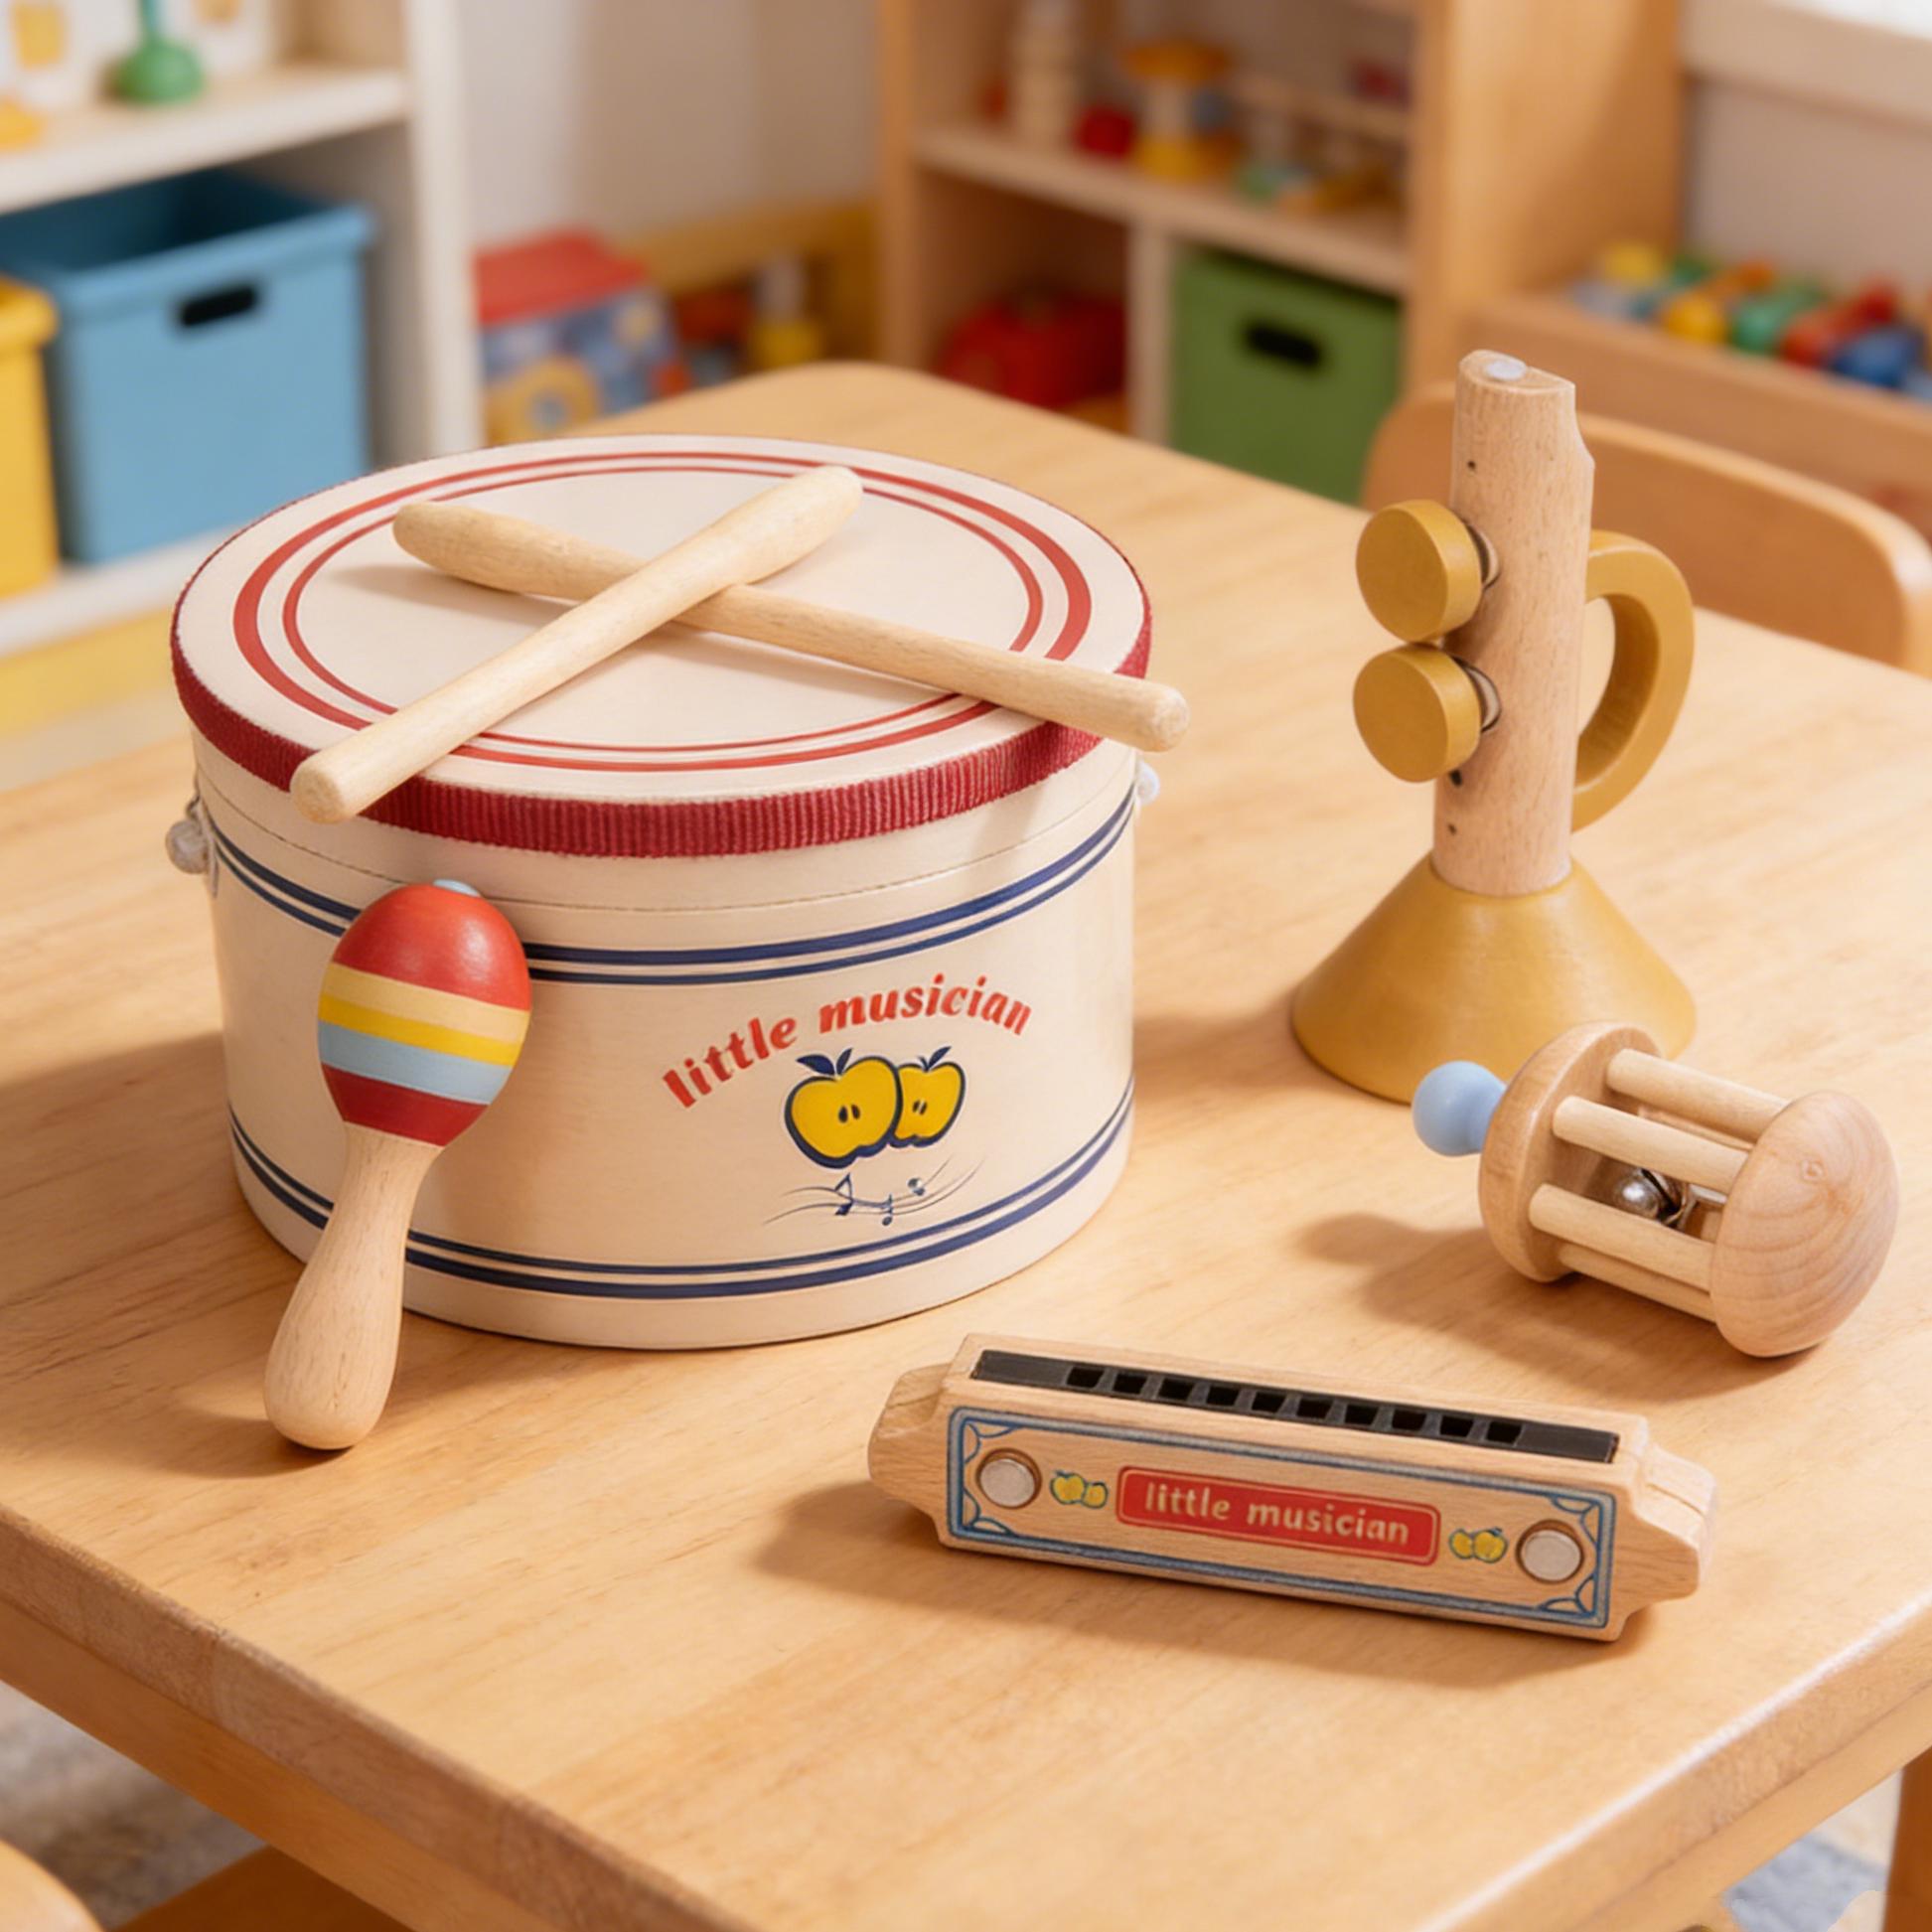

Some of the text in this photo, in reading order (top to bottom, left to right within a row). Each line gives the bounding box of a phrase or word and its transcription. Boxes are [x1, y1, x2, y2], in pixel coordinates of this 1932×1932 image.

[663, 973, 1032, 1109] little musician
[1144, 1482, 1411, 1546] little musician
